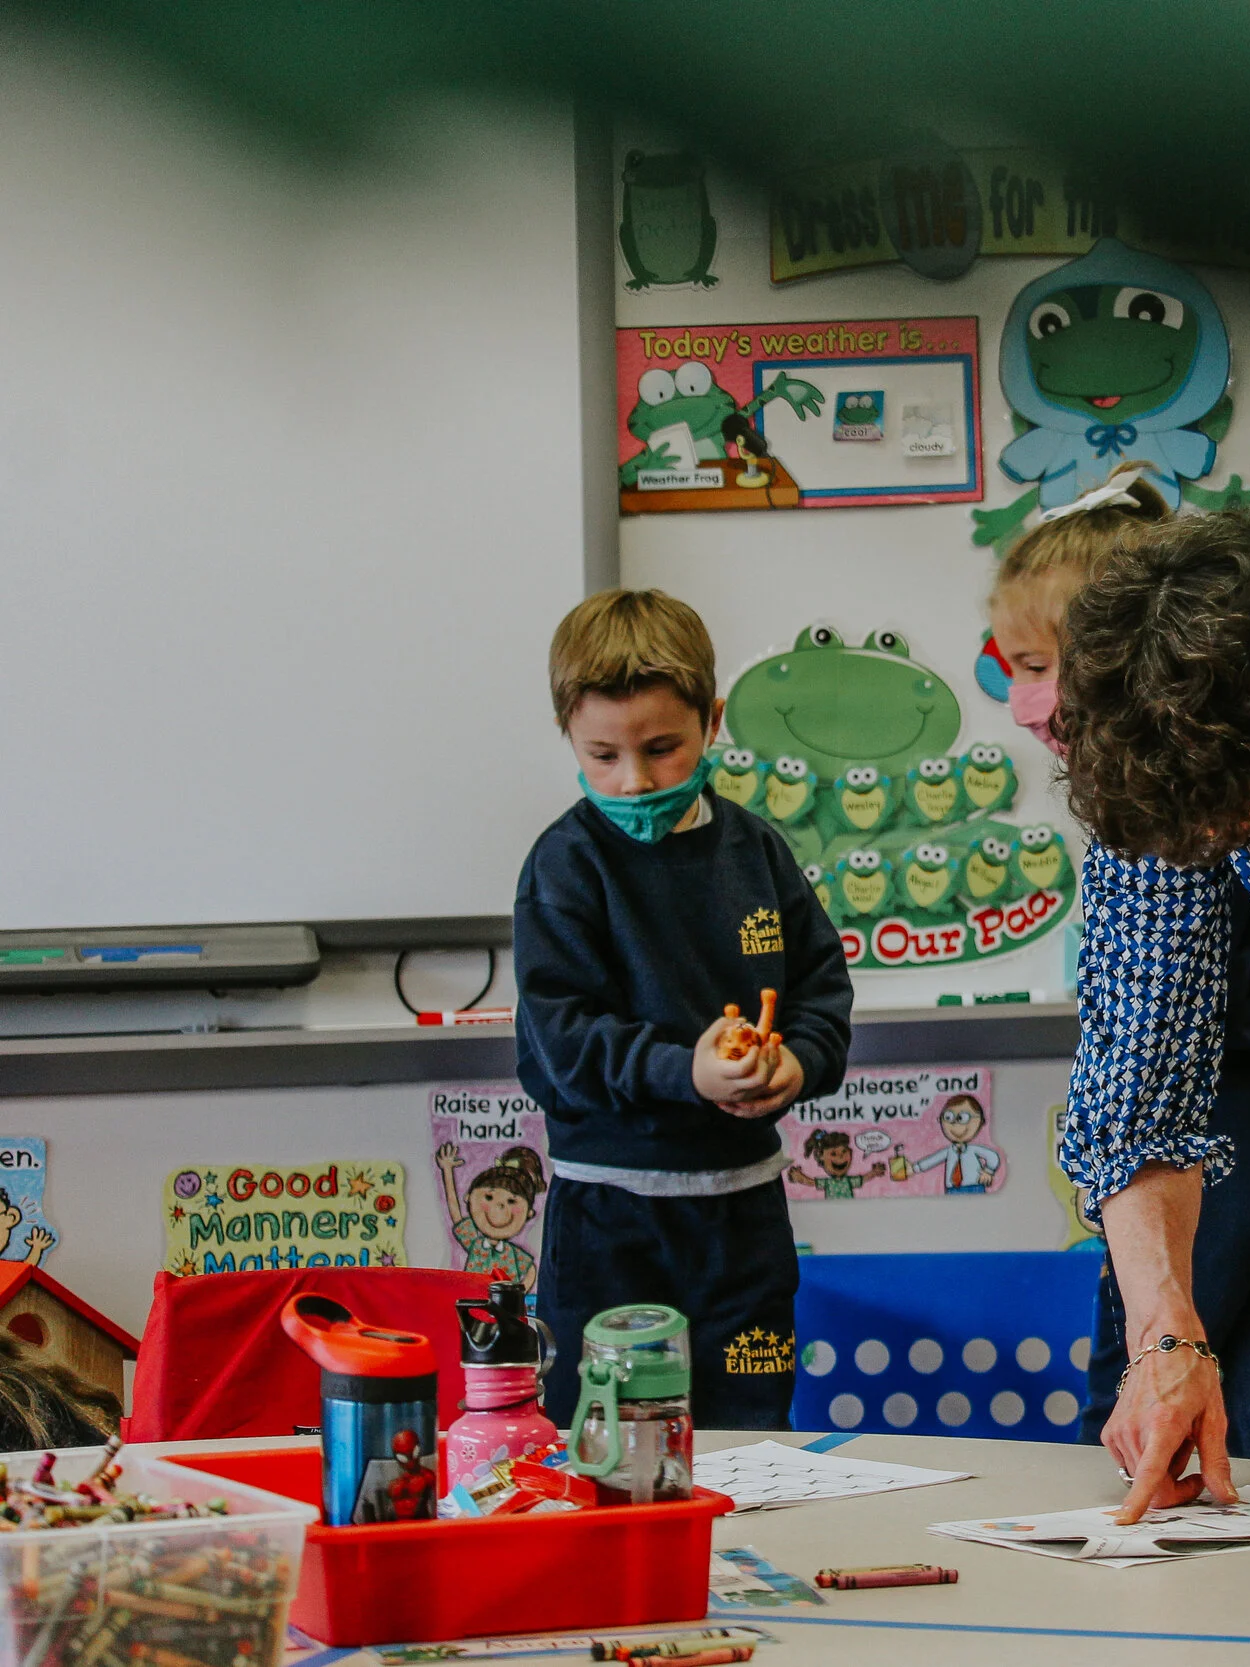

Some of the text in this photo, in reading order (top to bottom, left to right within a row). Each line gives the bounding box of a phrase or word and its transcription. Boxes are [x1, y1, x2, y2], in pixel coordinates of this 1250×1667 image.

[989, 165, 1043, 240] for
[640, 325, 961, 363] Today's weather is...
[844, 428, 868, 437] cool
[909, 442, 944, 452] cloudy
[641, 473, 720, 486] Weather Frog
[877, 923, 960, 958] Our
[936, 1072, 978, 1092] and
[434, 1094, 538, 1117] Raise you
[872, 1099, 929, 1122] you."
[459, 1118, 523, 1139] hand.
[226, 1164, 338, 1202] Good
[188, 1208, 380, 1249] Manners
[203, 1245, 370, 1275] Matter!
[741, 1346, 778, 1358] Saint
